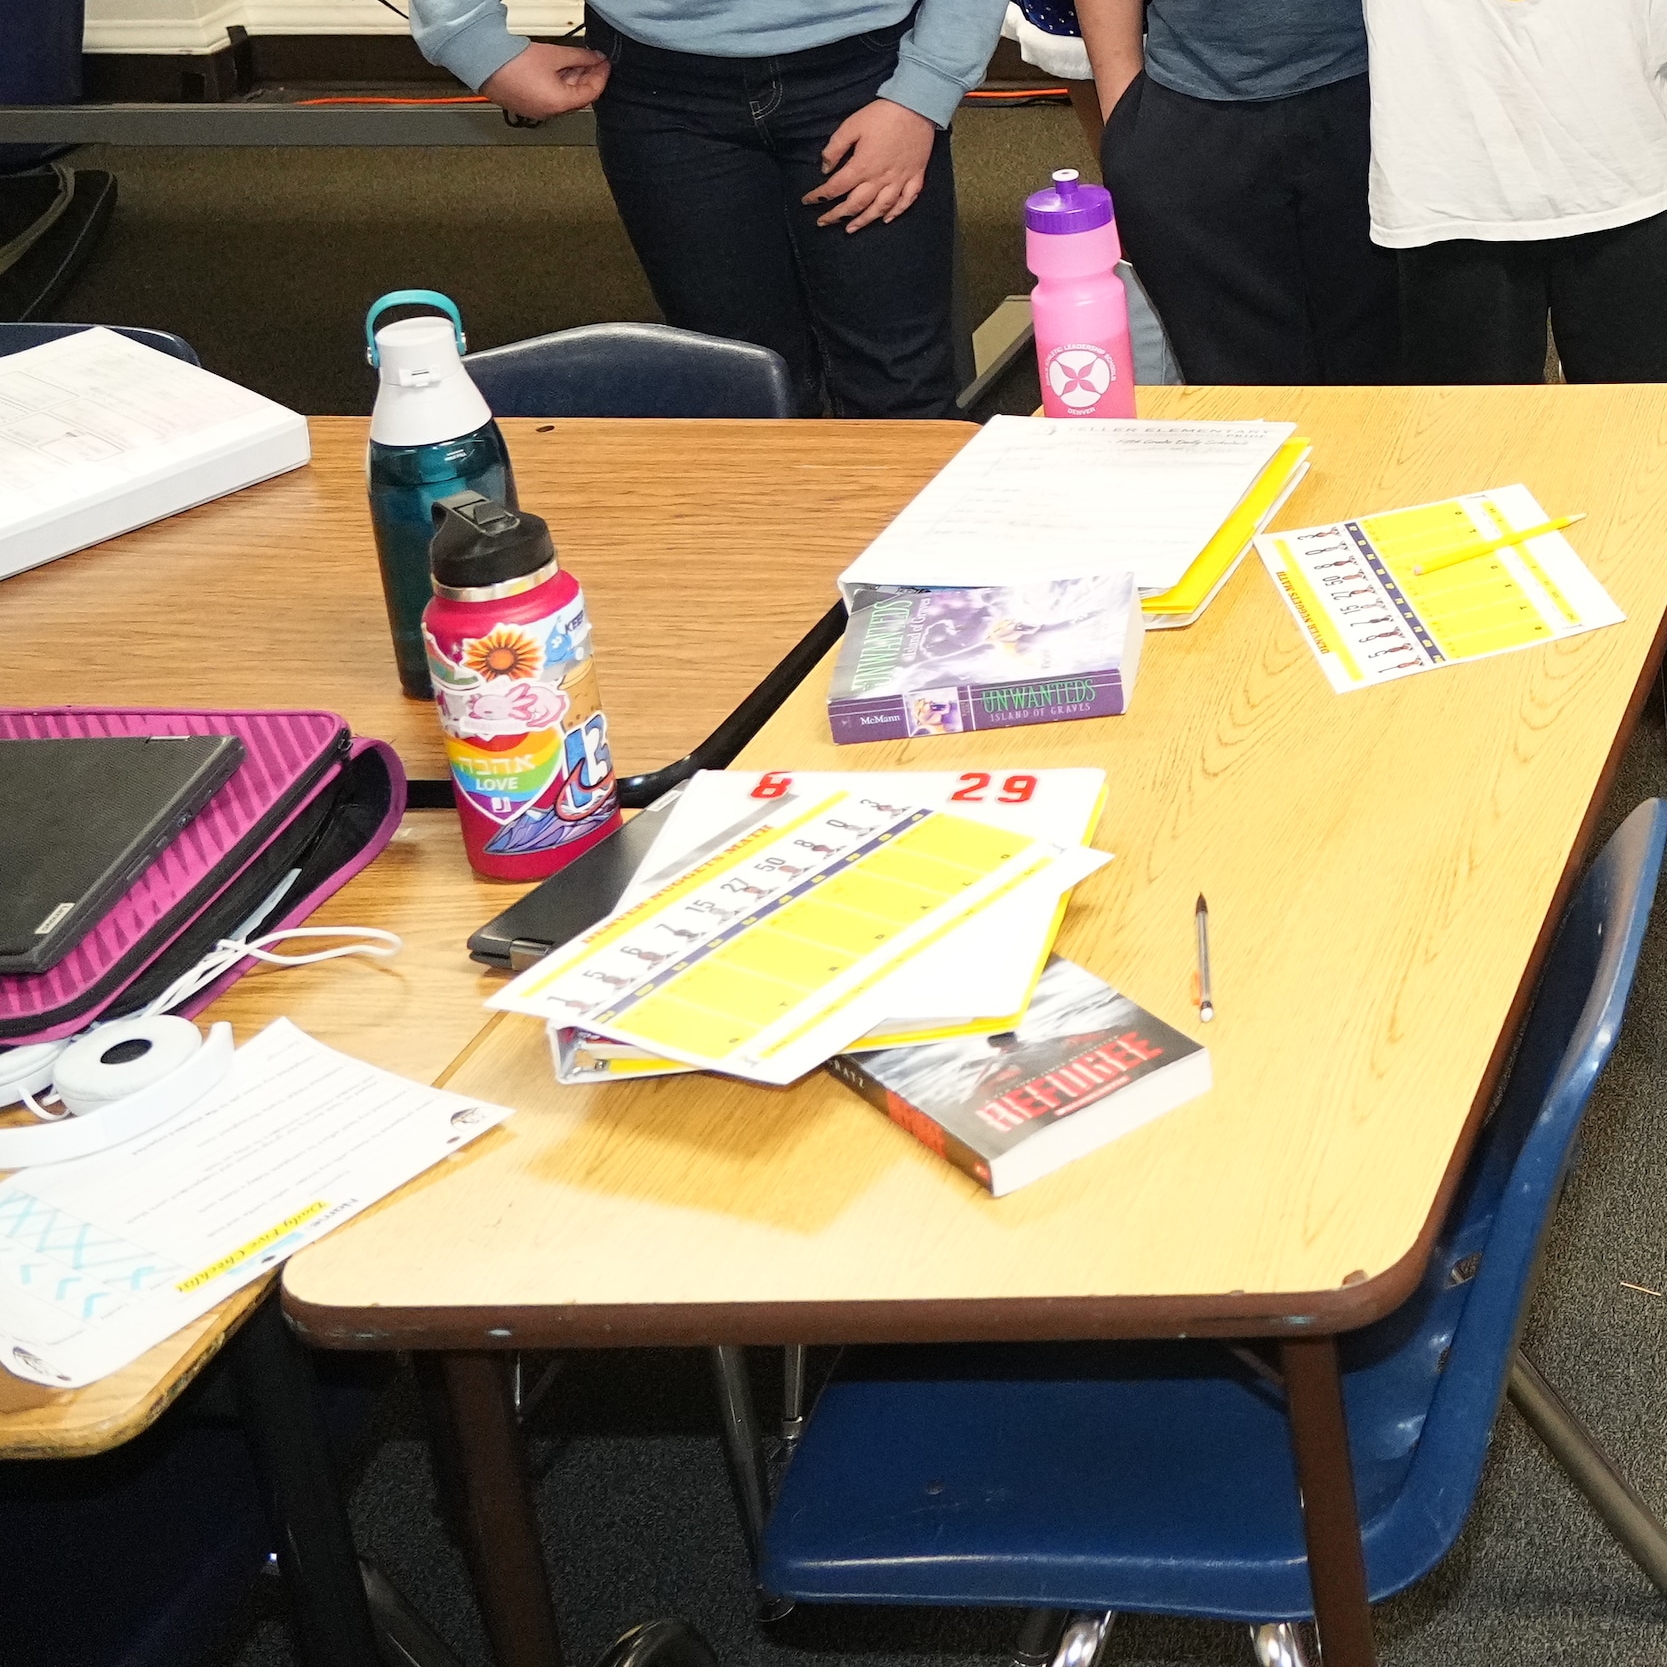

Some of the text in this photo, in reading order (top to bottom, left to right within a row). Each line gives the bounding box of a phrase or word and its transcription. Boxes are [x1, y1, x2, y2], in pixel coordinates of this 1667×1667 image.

[1067, 406, 1096, 416] DENVER
[990, 703, 1091, 722] ISLAND OF GRAVES
[860, 713, 900, 727] McMann
[475, 777, 518, 791] LOVE
[656, 850, 722, 902] NUGGETS
[725, 825, 775, 855] MATH
